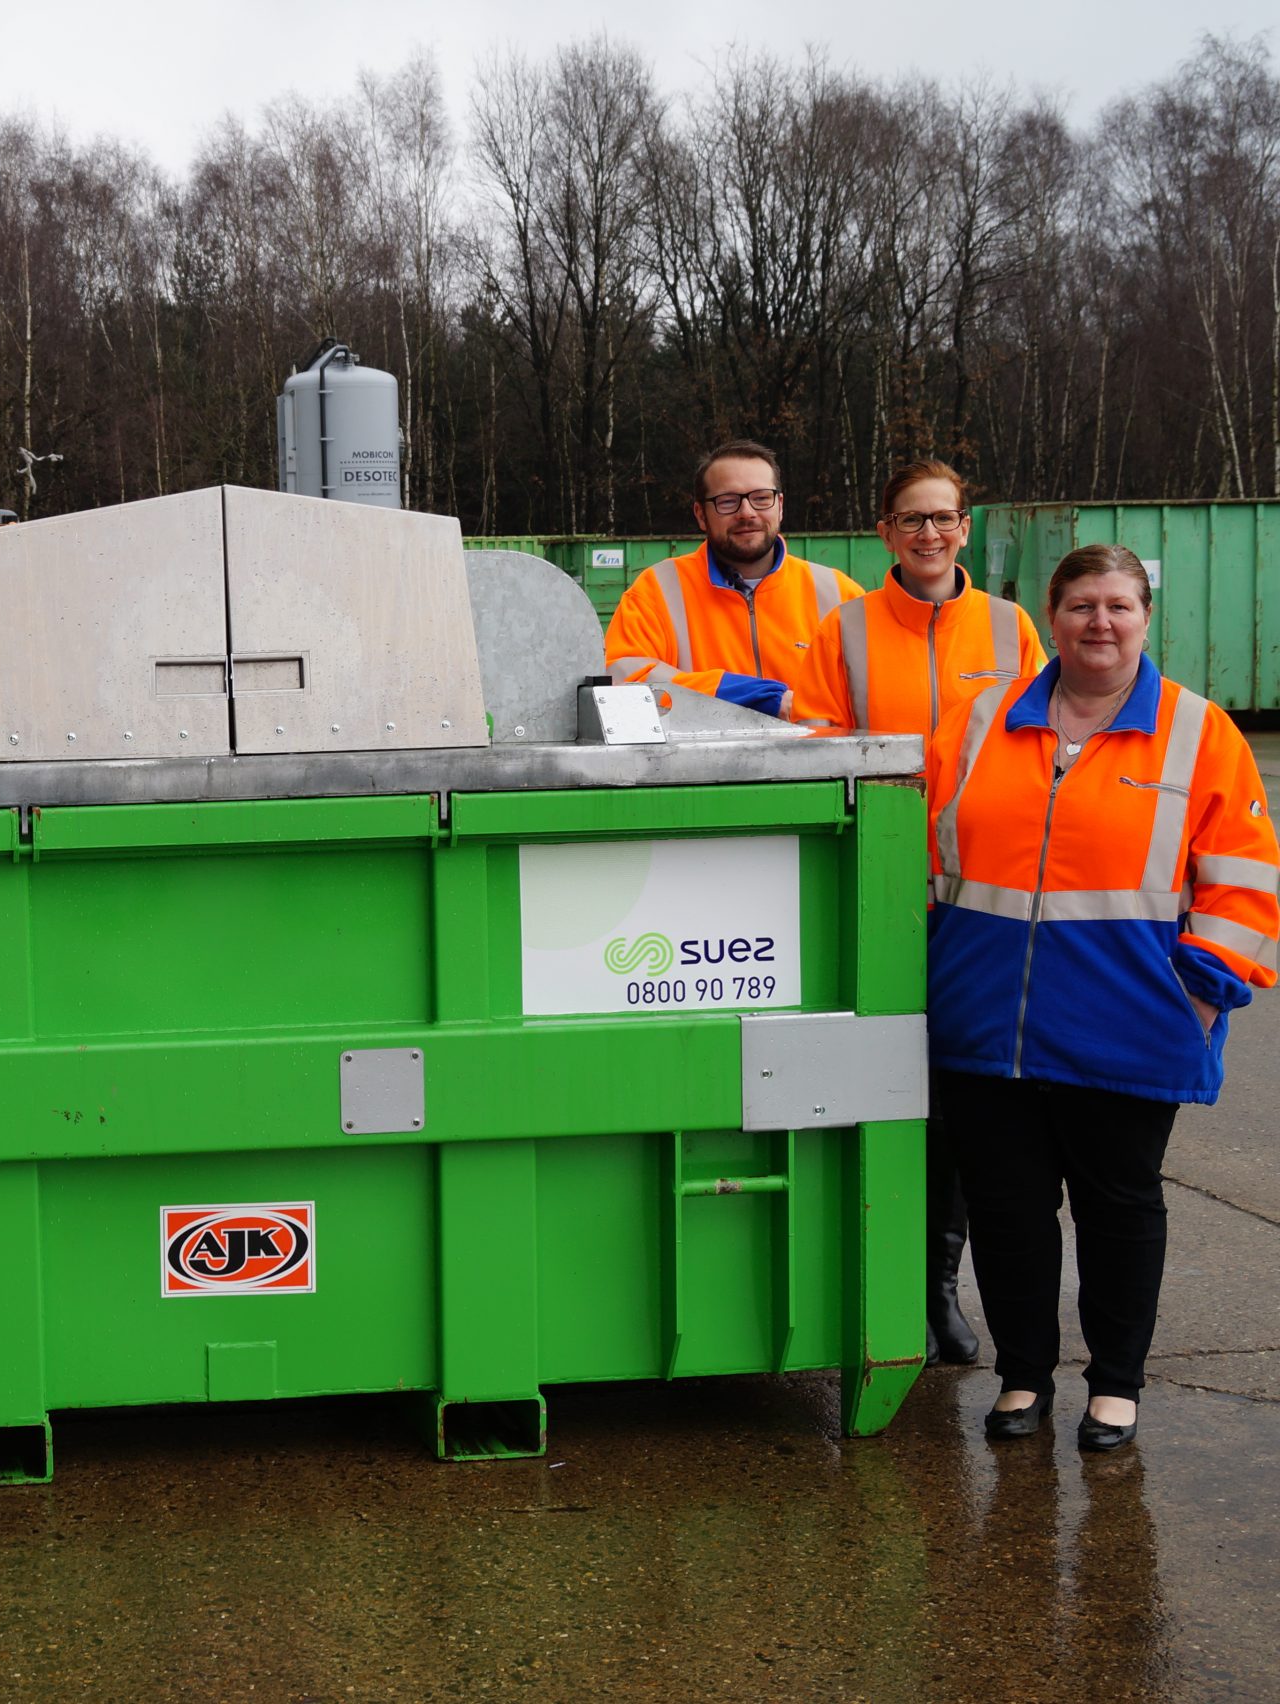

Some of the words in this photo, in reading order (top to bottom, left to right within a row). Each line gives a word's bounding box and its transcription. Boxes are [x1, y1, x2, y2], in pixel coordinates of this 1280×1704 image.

[352, 450, 394, 459] MOBICON
[344, 470, 398, 482] DESOTEC
[680, 937, 775, 965] suez
[627, 980, 686, 1005] 0800
[695, 978, 724, 1002] 90
[732, 976, 776, 1000] 789
[188, 1227, 283, 1277] AJK
